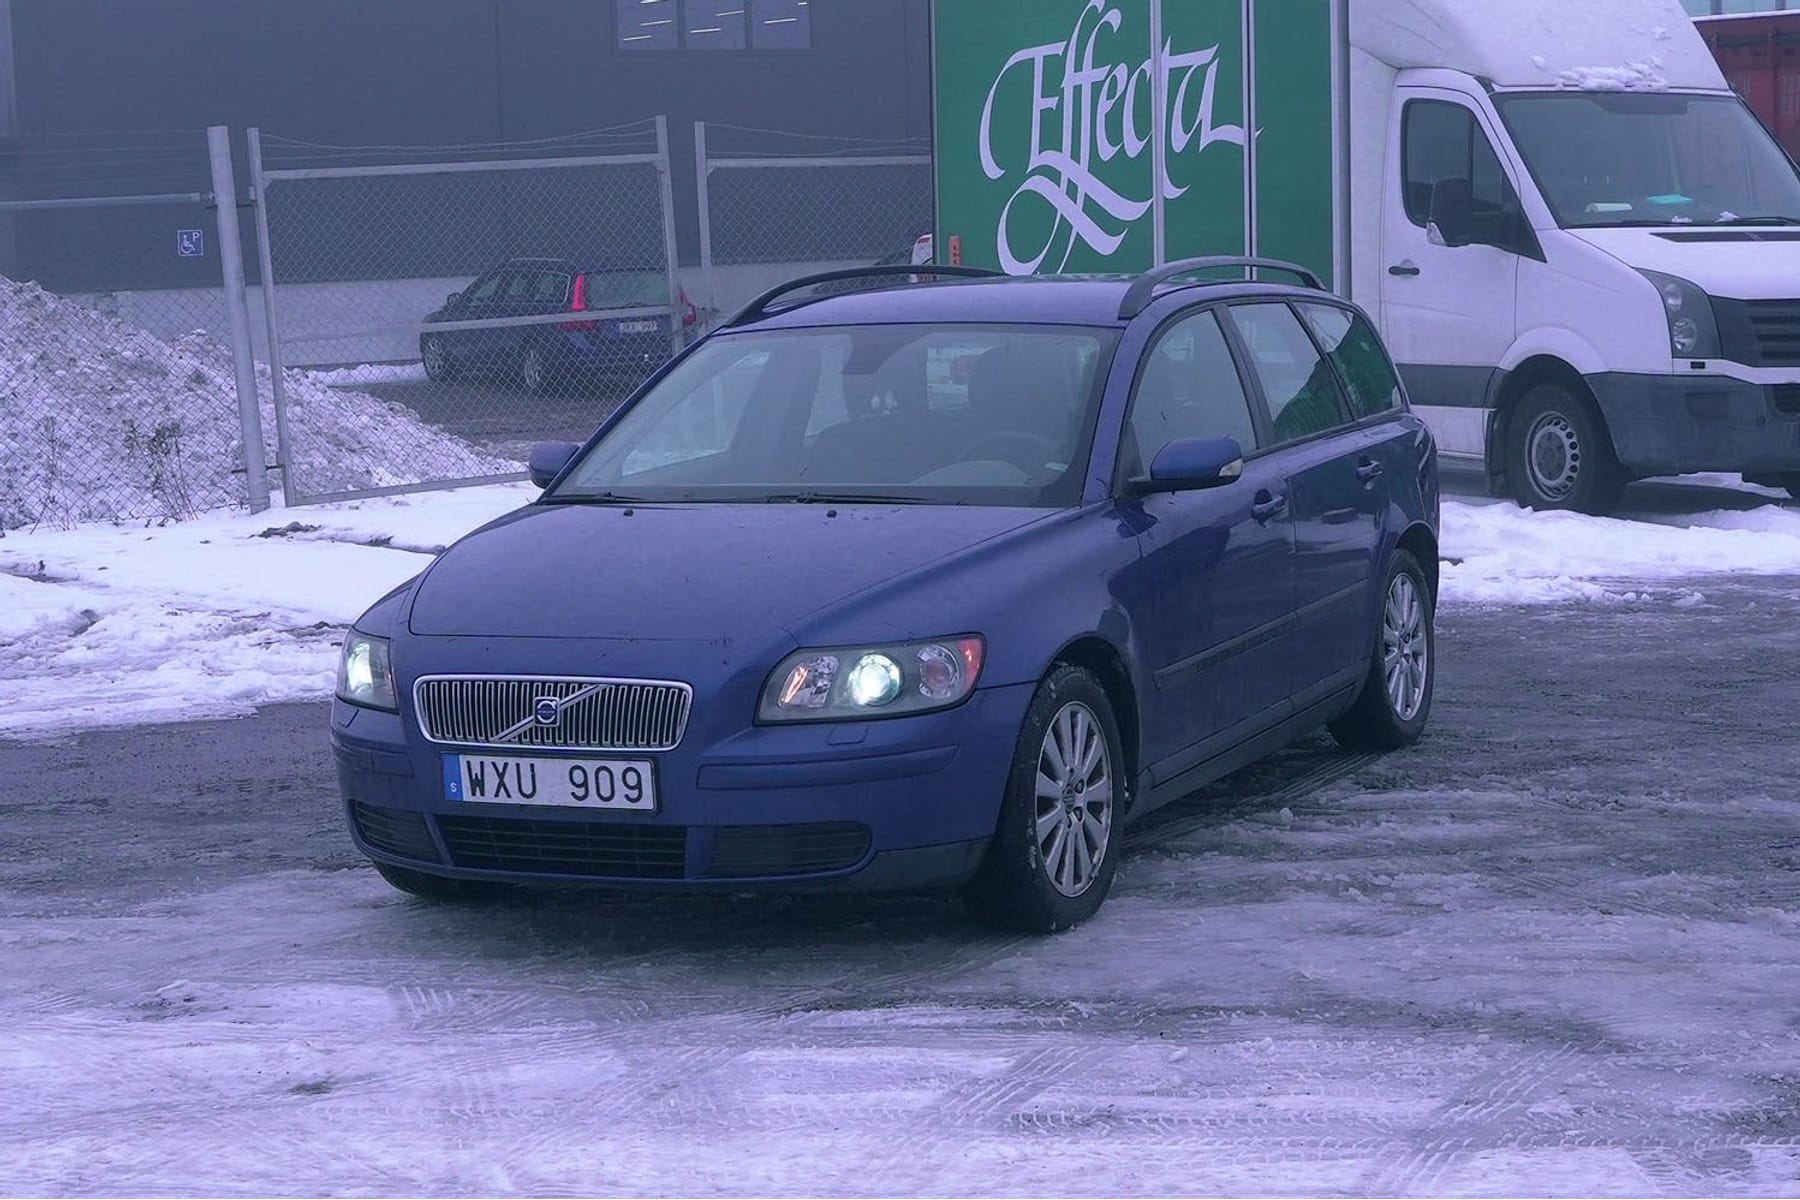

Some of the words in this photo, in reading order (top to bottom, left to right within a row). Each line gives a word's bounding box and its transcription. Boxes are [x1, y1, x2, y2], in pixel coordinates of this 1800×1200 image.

[979, 0, 1264, 275] Effecta
[192, 231, 200, 241] P
[450, 782, 458, 792] S
[466, 760, 537, 799] WXU
[568, 764, 643, 803] 909
